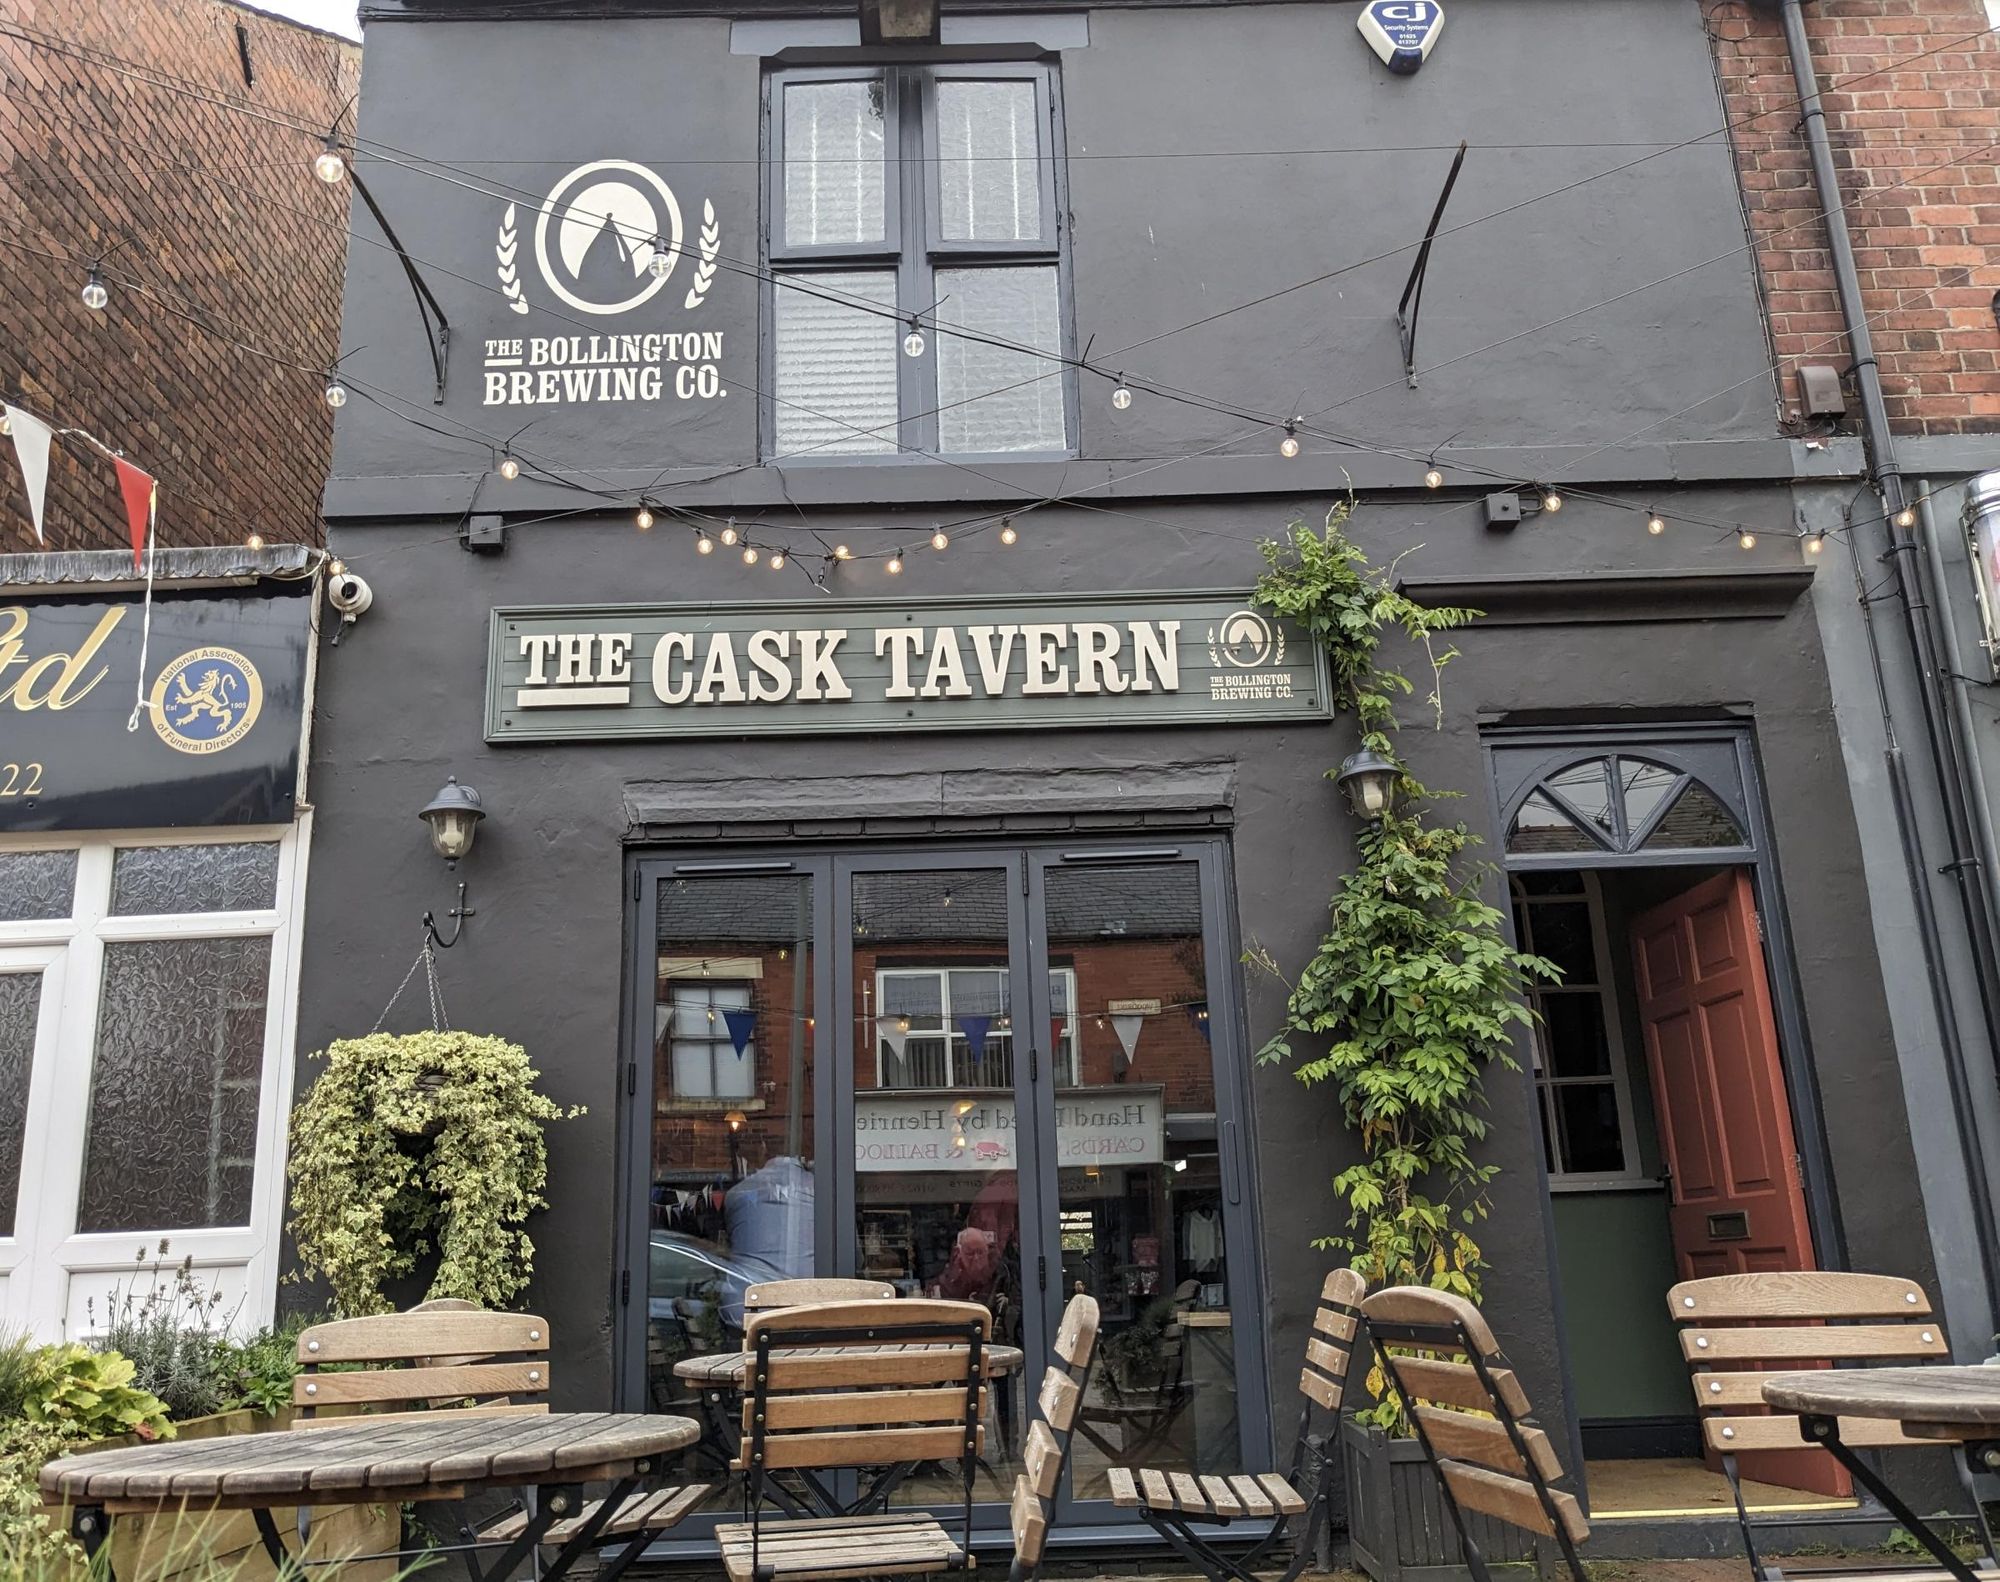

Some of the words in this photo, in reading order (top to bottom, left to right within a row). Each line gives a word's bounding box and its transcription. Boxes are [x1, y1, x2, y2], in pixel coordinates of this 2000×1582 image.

[485, 339, 523, 357] THE
[529, 331, 724, 366] BOLLINGTON
[483, 366, 663, 406] BREWING
[675, 364, 727, 400] CO.
[161, 652, 199, 684] National
[201, 649, 255, 678] Association
[520, 632, 632, 685] THE
[652, 629, 852, 705] CASK
[875, 620, 1181, 698] TAVERN
[1211, 686, 1272, 700] BREWING
[1276, 686, 1294, 698] CO.
[1225, 674, 1291, 686] BOLLINGTON
[231, 702, 247, 710] 1905
[157, 722, 167, 735] of
[165, 731, 201, 752] Funeral
